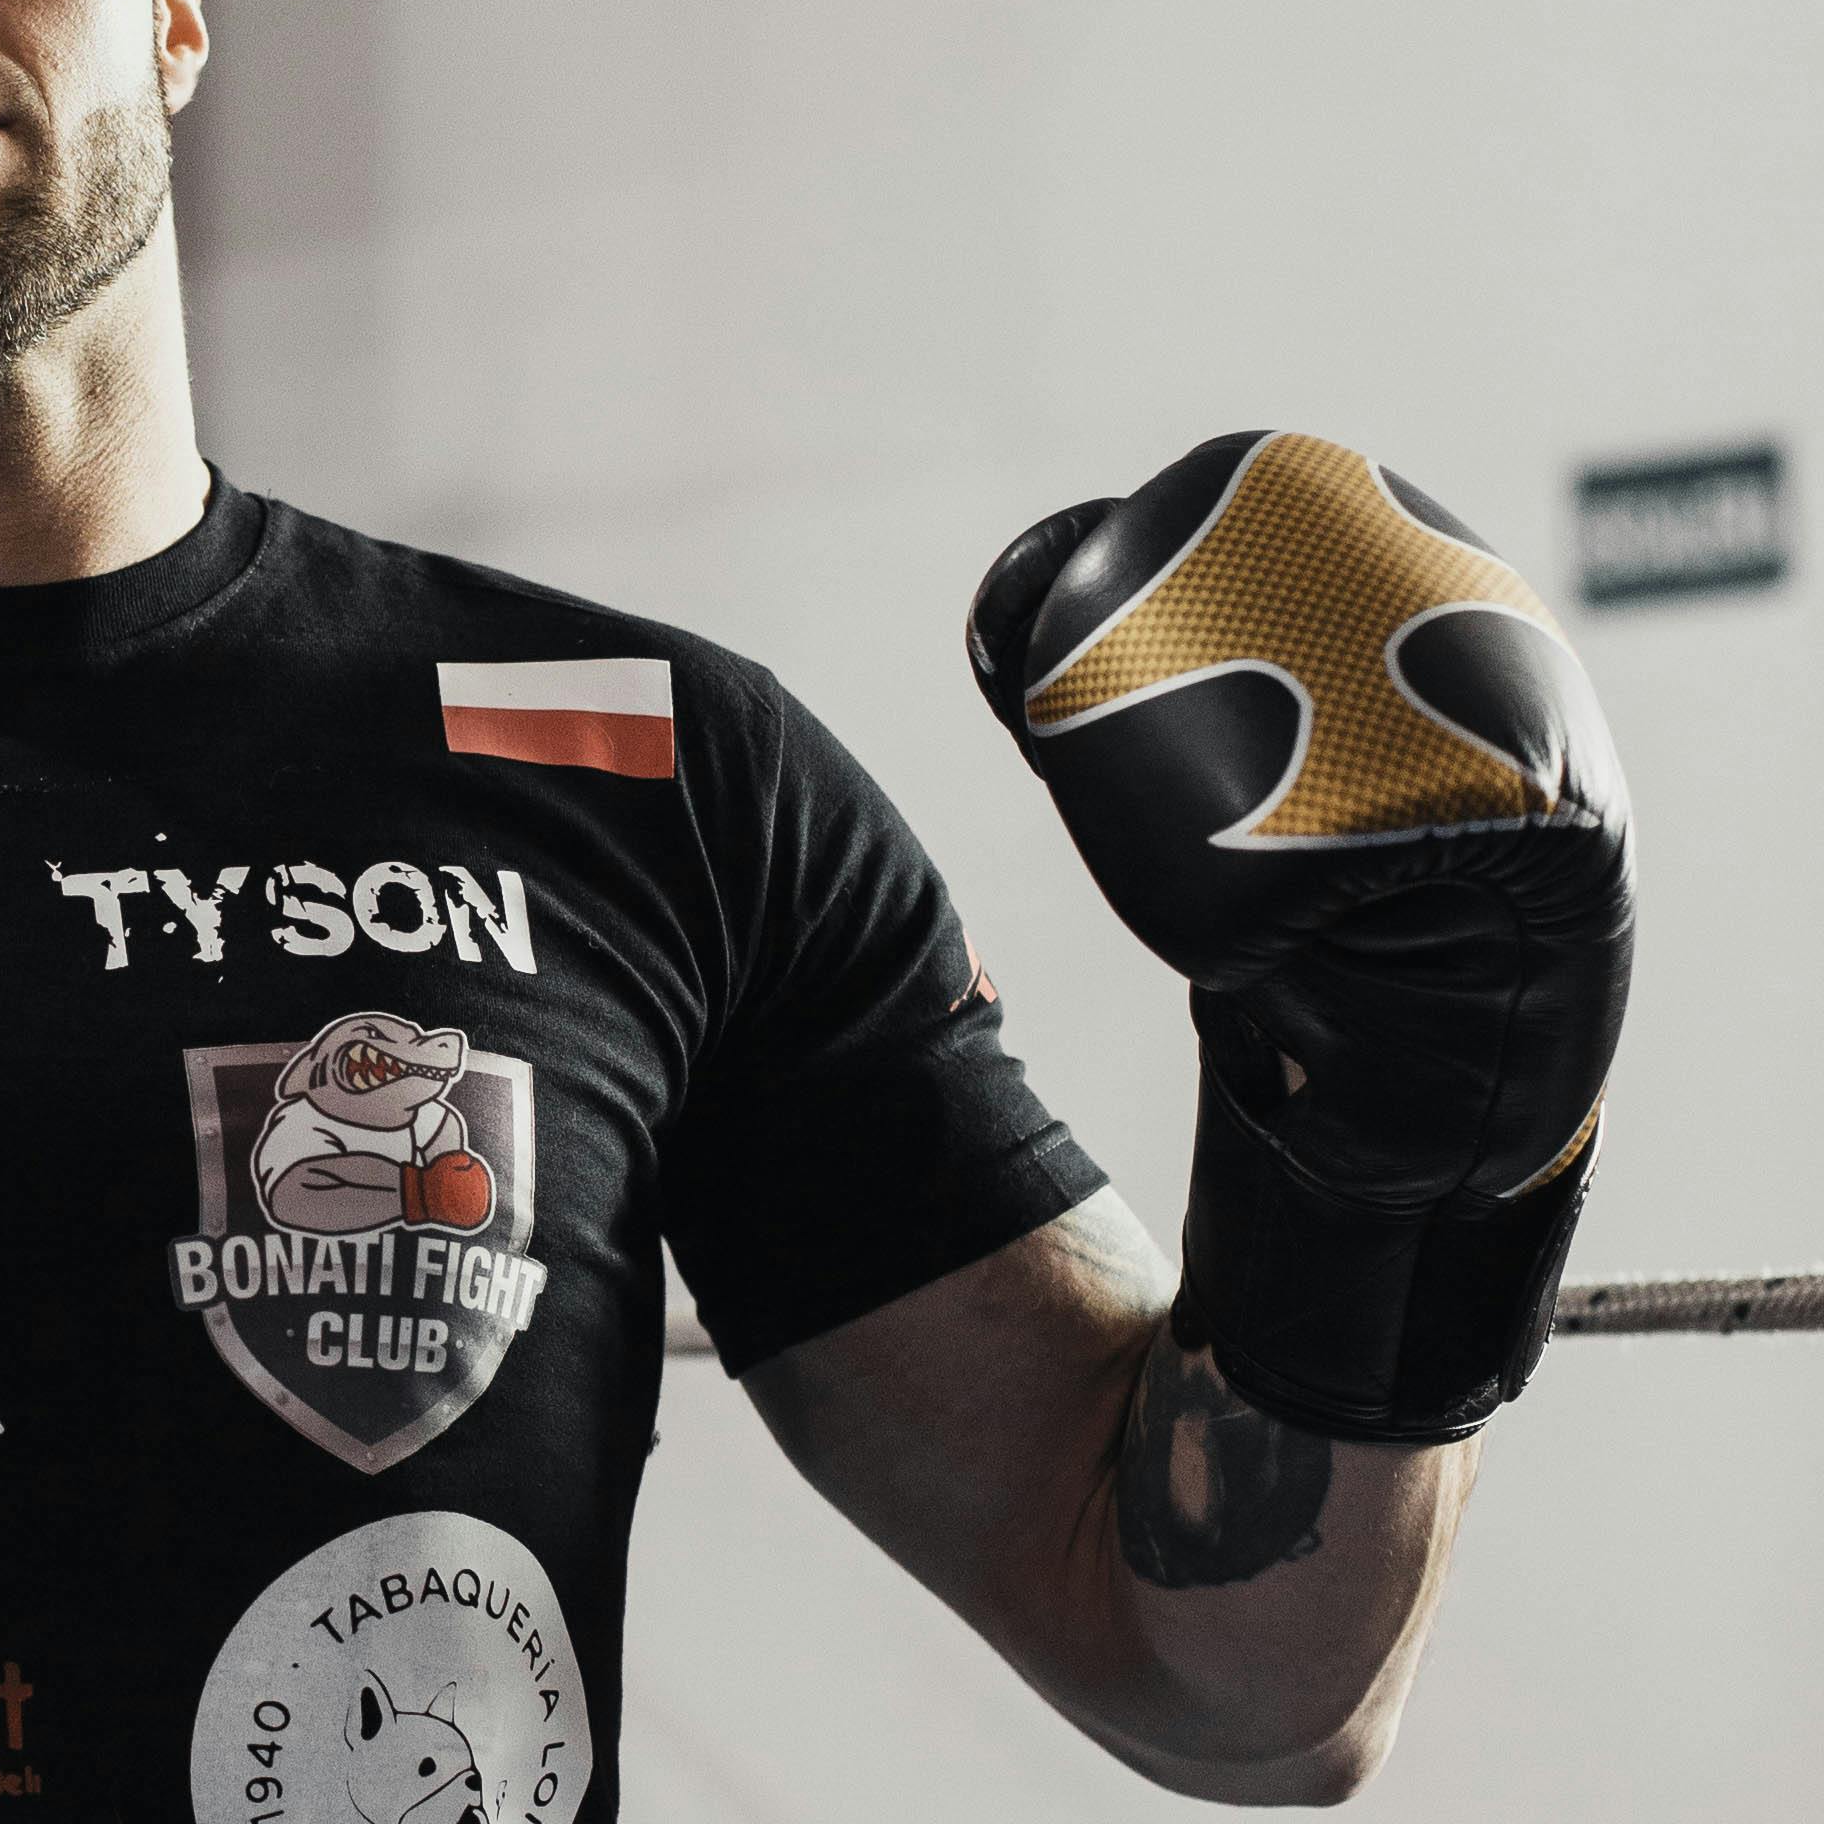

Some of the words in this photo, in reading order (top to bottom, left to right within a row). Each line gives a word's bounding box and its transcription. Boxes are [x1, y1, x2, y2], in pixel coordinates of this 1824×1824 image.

[59, 860, 537, 975] TYSON
[175, 1232, 396, 1306] BONATI
[413, 1236, 545, 1329] FIGHT
[306, 1310, 450, 1374] CLUB
